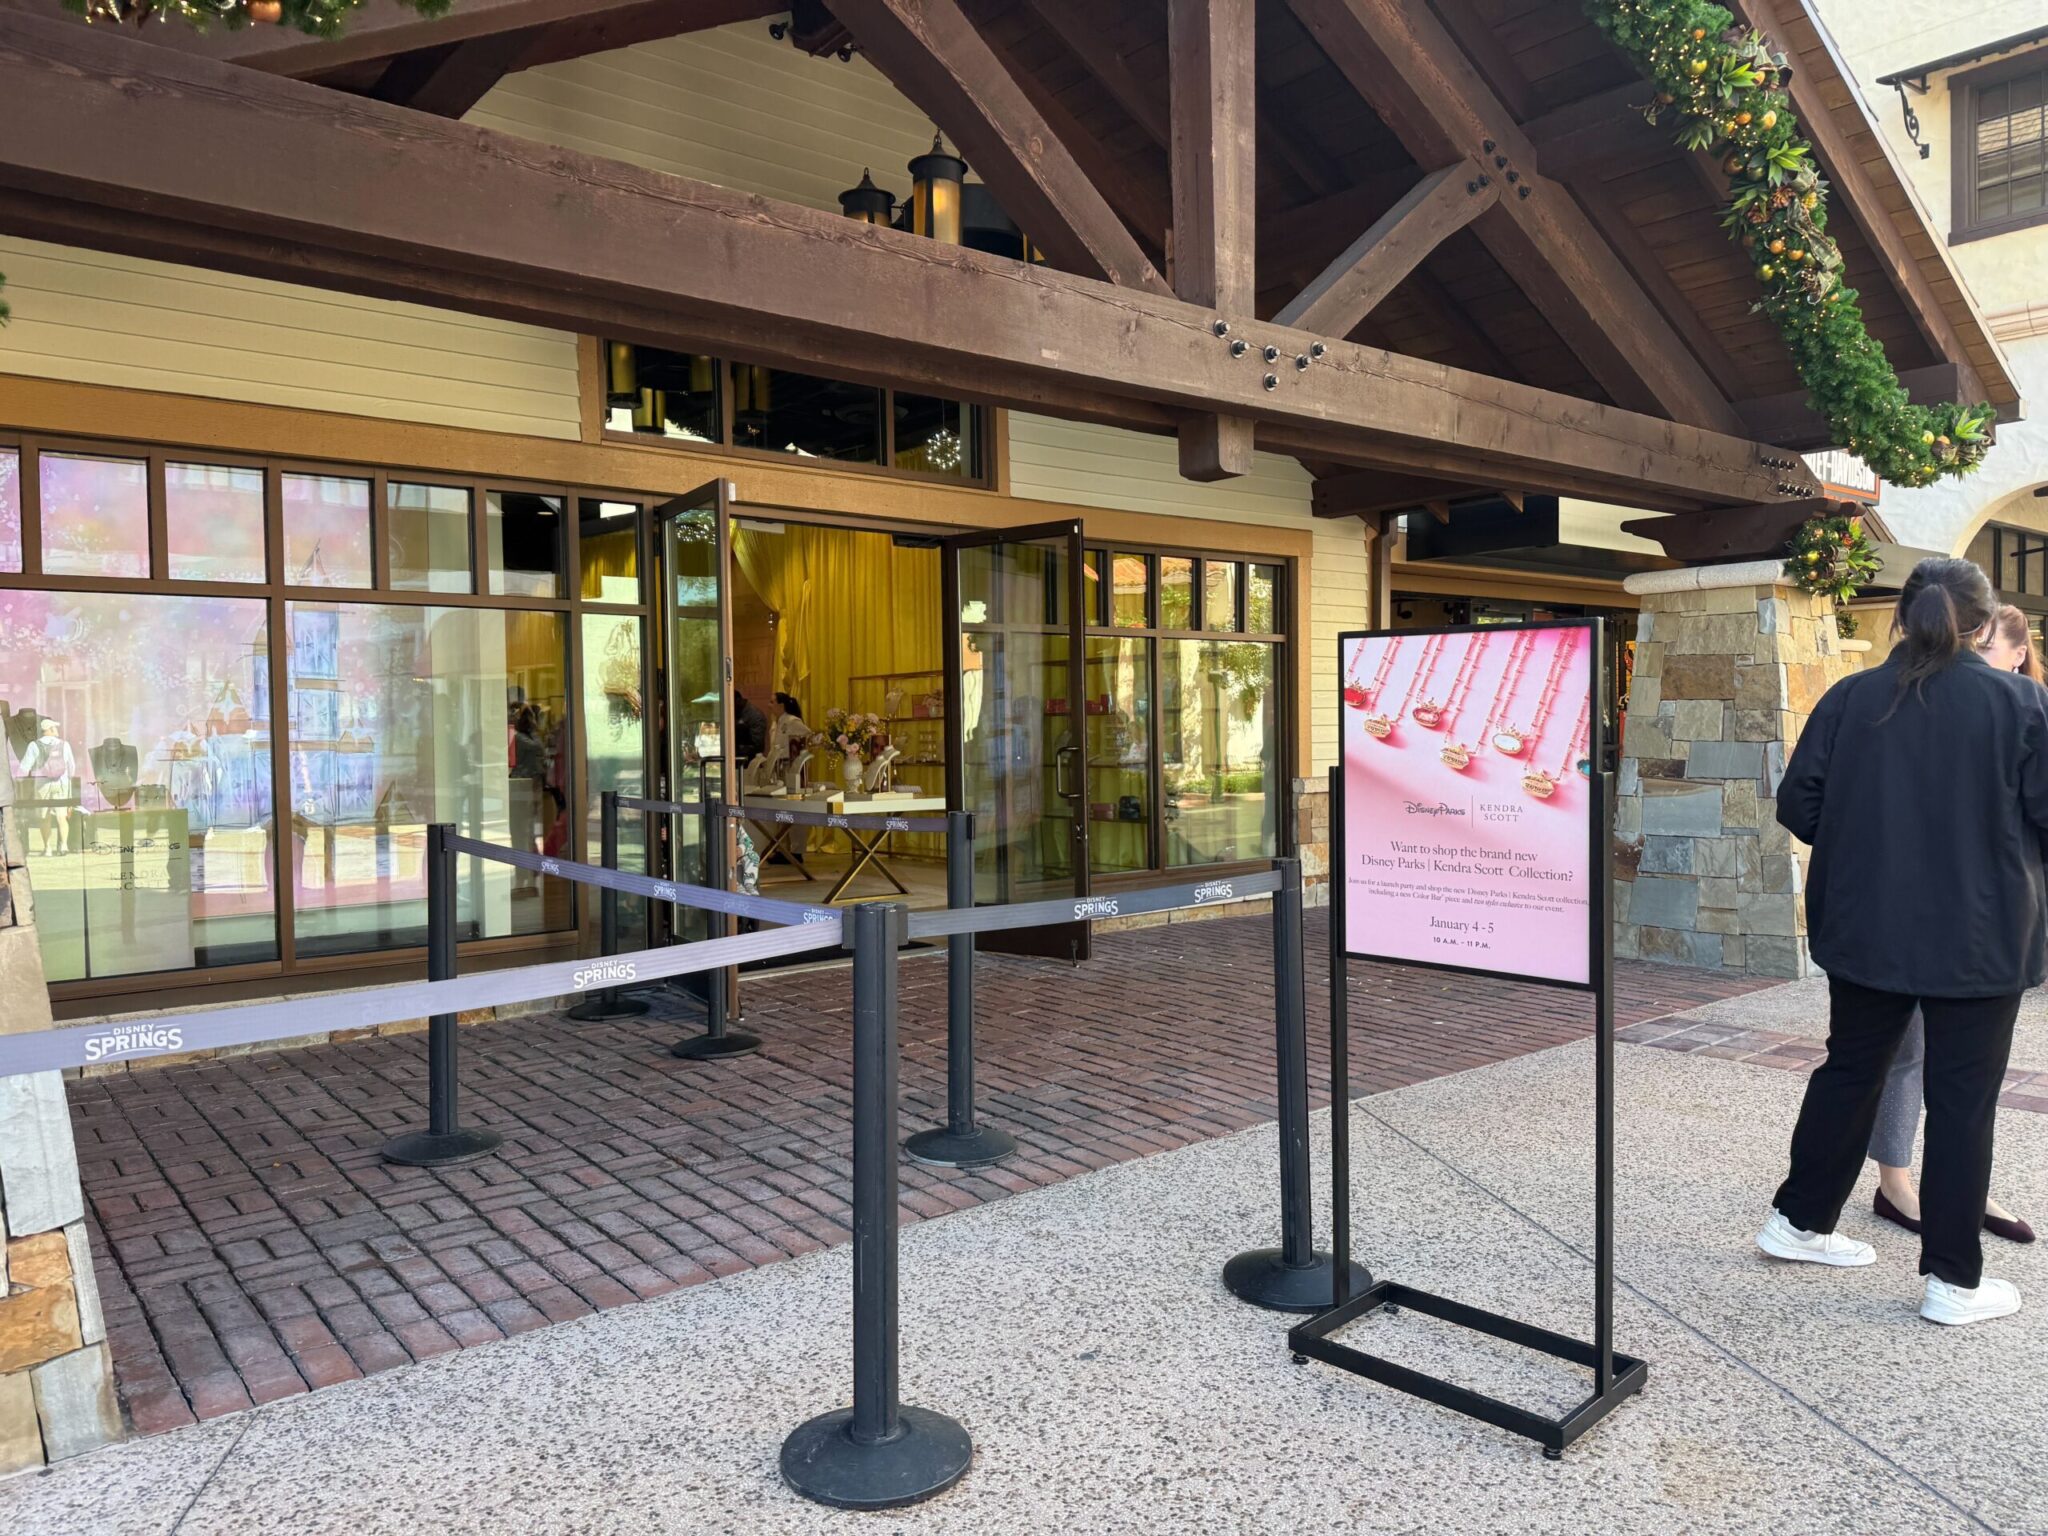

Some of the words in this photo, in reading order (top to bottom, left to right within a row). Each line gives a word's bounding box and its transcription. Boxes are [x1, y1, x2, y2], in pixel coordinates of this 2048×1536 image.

[1403, 801, 1439, 816] Disney
[1439, 803, 1466, 816] Parks
[1480, 804, 1523, 813] KENDRA
[886, 820, 908, 831] SPRINGS
[1484, 814, 1519, 822] SCOTT
[1391, 841, 1417, 853] Want
[1420, 846, 1430, 854] to
[1432, 844, 1457, 859] shop
[1460, 846, 1477, 858] the
[1480, 847, 1511, 860] brand
[1515, 852, 1538, 861] new
[1361, 854, 1394, 870] Disney
[1398, 857, 1425, 870] Parks
[1434, 860, 1472, 874] Kendra
[1474, 863, 1504, 876] Scott
[1509, 865, 1574, 881] Collection?
[654, 885, 676, 900] SPRINGS
[1194, 884, 1233, 903] SPRINGS
[1400, 882, 1414, 890] party
[1428, 884, 1442, 893] shop
[1467, 888, 1488, 898] Disney
[1490, 890, 1507, 898] Parks
[1512, 892, 1536, 900] Kendra
[1537, 894, 1554, 902] Scott
[1074, 900, 1119, 920] SPRINGS
[1430, 916, 1469, 933] January
[1472, 921, 1479, 932] 4
[1488, 922, 1494, 933] 5
[1475, 941, 1491, 949] P.M.
[591, 960, 618, 969] DISNEY
[573, 963, 636, 989] SPRINGS
[113, 1024, 154, 1036] DISNEY
[85, 1028, 183, 1060] SPRINGS
